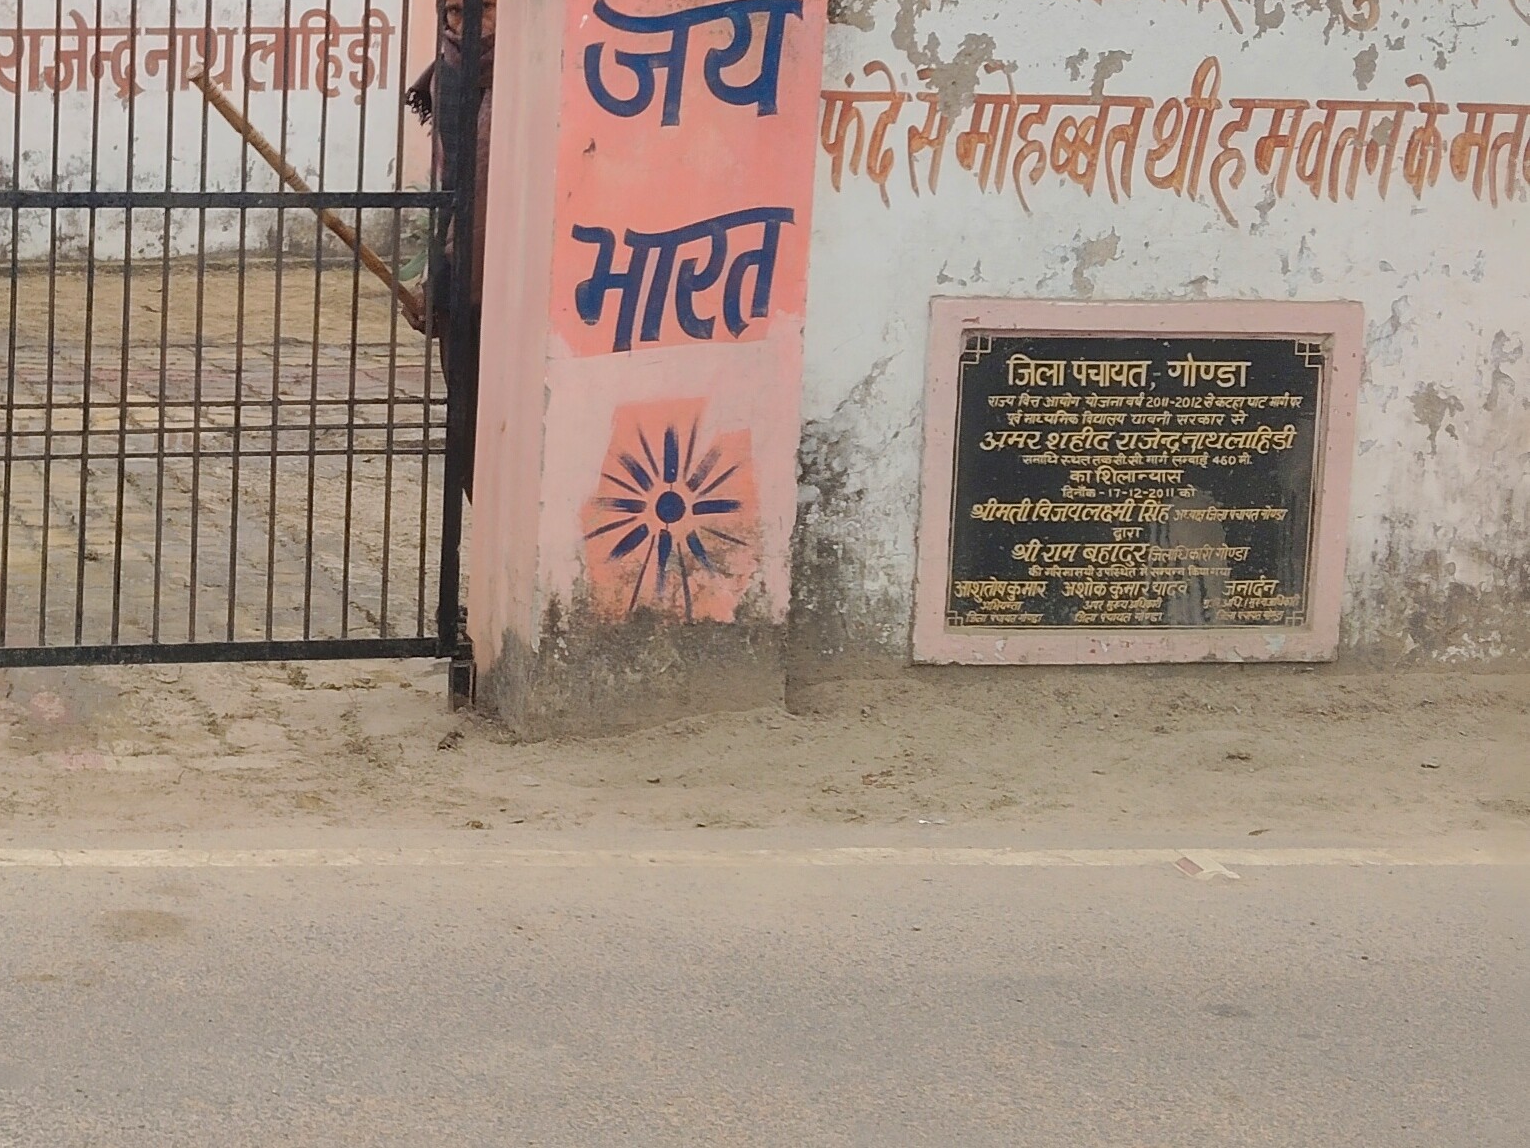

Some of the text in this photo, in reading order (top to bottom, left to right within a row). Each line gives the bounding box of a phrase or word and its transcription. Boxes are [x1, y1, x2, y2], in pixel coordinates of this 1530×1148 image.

[1145, 56, 1222, 201] थी
[1403, 73, 1450, 201] के
[571, 206, 795, 353] भारत
[1006, 353, 1067, 386] जिला
[1166, 353, 1252, 388] गोण्डा
[988, 395, 1017, 408] राज्य
[1019, 392, 1043, 408] वित्त
[1043, 392, 1081, 408] आयोग
[1085, 392, 1125, 408] योजना
[1126, 391, 1145, 408] वर्ष
[1146, 396, 1202, 408] 2011-2012
[1204, 392, 1216, 408] से
[1290, 395, 1304, 408] पर
[1006, 410, 1022, 428] पूर्व
[1081, 410, 1128, 427] विद्यालय
[1176, 413, 1226, 426] सरकार
[1230, 409, 1248, 425] से
[979, 430, 1042, 452] अमर
[1045, 426, 1117, 452] शहीद
[1060, 454, 1091, 466] स्थल
[1092, 454, 1112, 466] तक
[1171, 452, 1208, 468] लम्बाई
[1212, 455, 1237, 465] 460
[1070, 465, 1185, 484] का शिलान्यास
[1108, 487, 1175, 499] 17-12-2011
[1178, 484, 1198, 498] को
[970, 497, 1034, 524] श्रीमती
[1032, 498, 1136, 523] विजयलक्ष्मी
[1137, 499, 1174, 523] सिंह
[1173, 508, 1205, 523] अध्यक्ष
[1206, 505, 1228, 521] जिला
[1260, 505, 1288, 521] गोण्डा
[1111, 526, 1143, 541] द्वारा
[1011, 539, 1252, 567] श्री राम बहादुर जिलाधिकारी गोण्डा
[954, 576, 1049, 603] आशुतोष कुमार
[1061, 577, 1189, 600] अशोक कुमार यादव
[1222, 575, 1280, 597] जनार्दन
